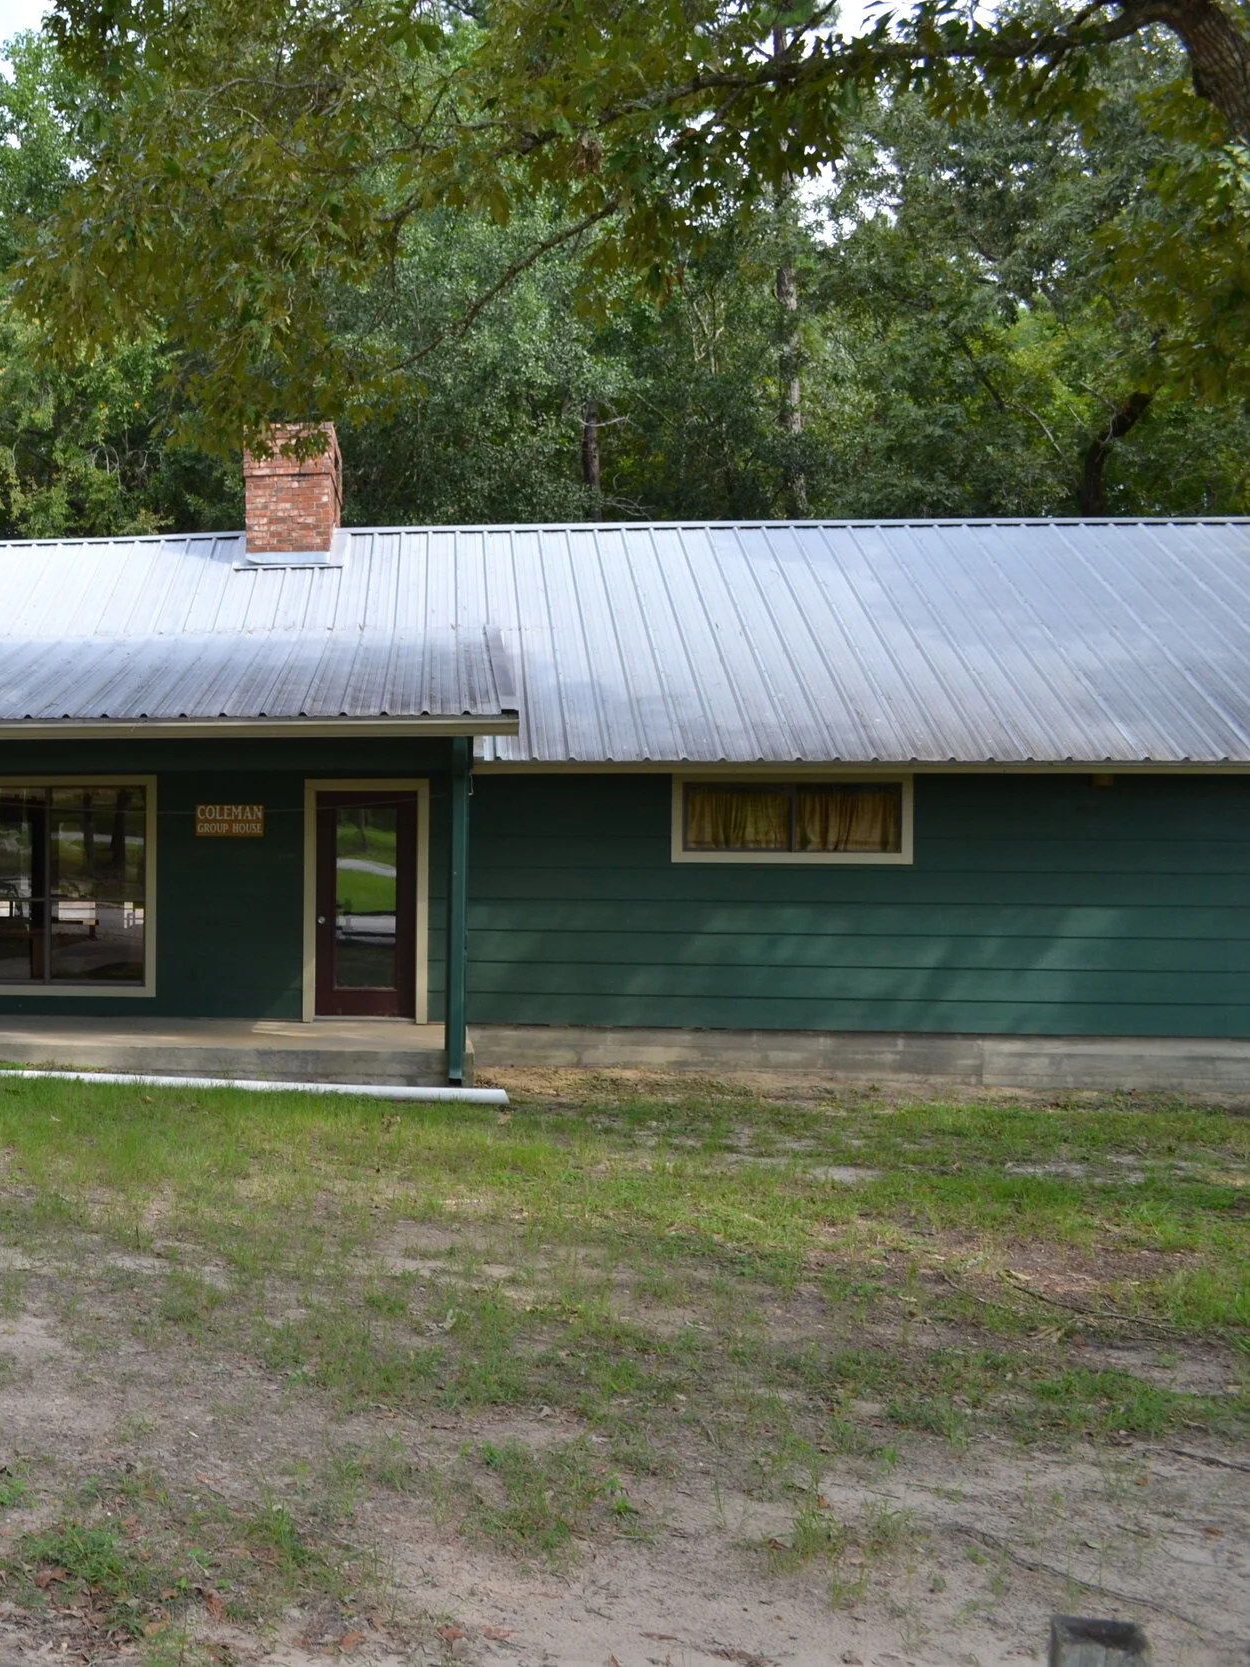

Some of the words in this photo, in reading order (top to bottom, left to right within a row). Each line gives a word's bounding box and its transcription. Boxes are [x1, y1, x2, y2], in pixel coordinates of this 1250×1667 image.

[197, 805, 263, 819] COLEMAN
[197, 823, 228, 833] GROUP
[232, 823, 262, 833] HOUSE
